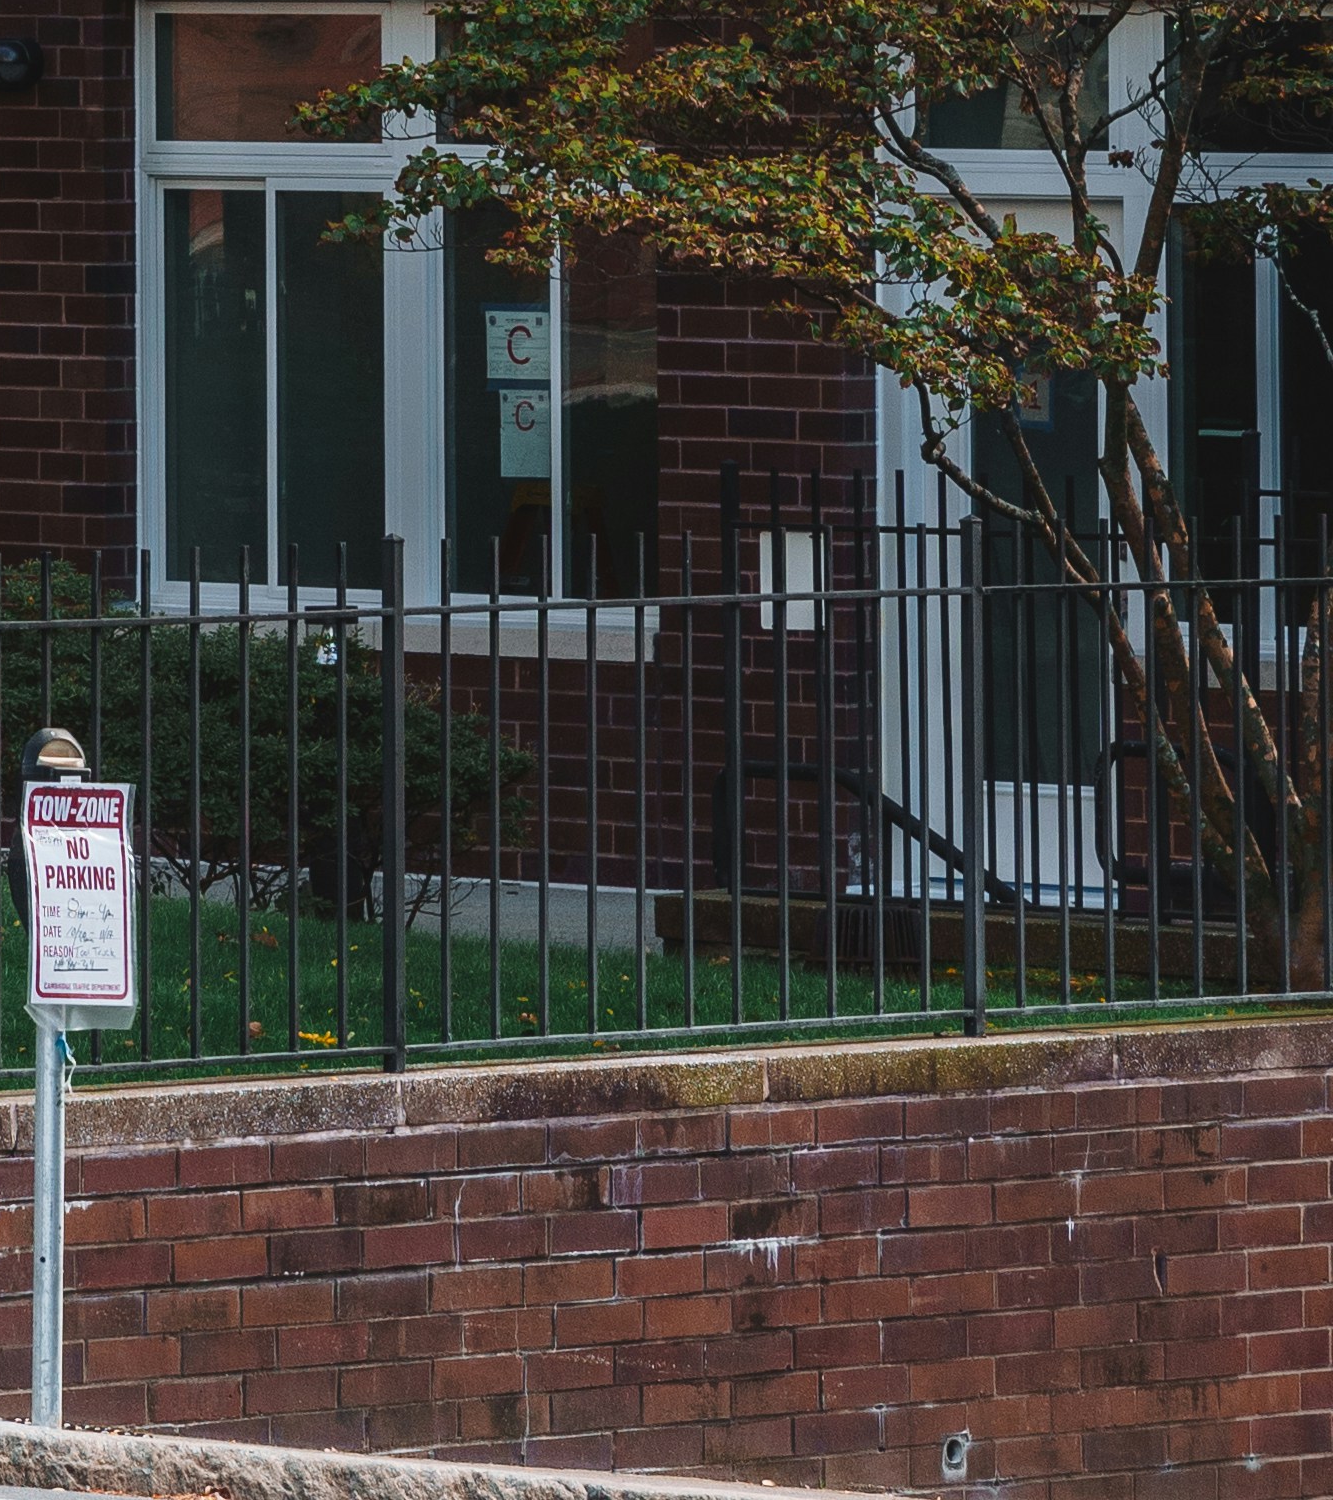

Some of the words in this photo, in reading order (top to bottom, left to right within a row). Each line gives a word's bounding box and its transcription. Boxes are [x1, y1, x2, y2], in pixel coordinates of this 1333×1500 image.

[33, 795, 120, 823] TOW-ZONE
[66, 836, 90, 860] NO
[45, 865, 116, 891] PARKING
[42, 906, 61, 918] TIME
[43, 925, 62, 938] DATE
[43, 945, 74, 958] REASON
